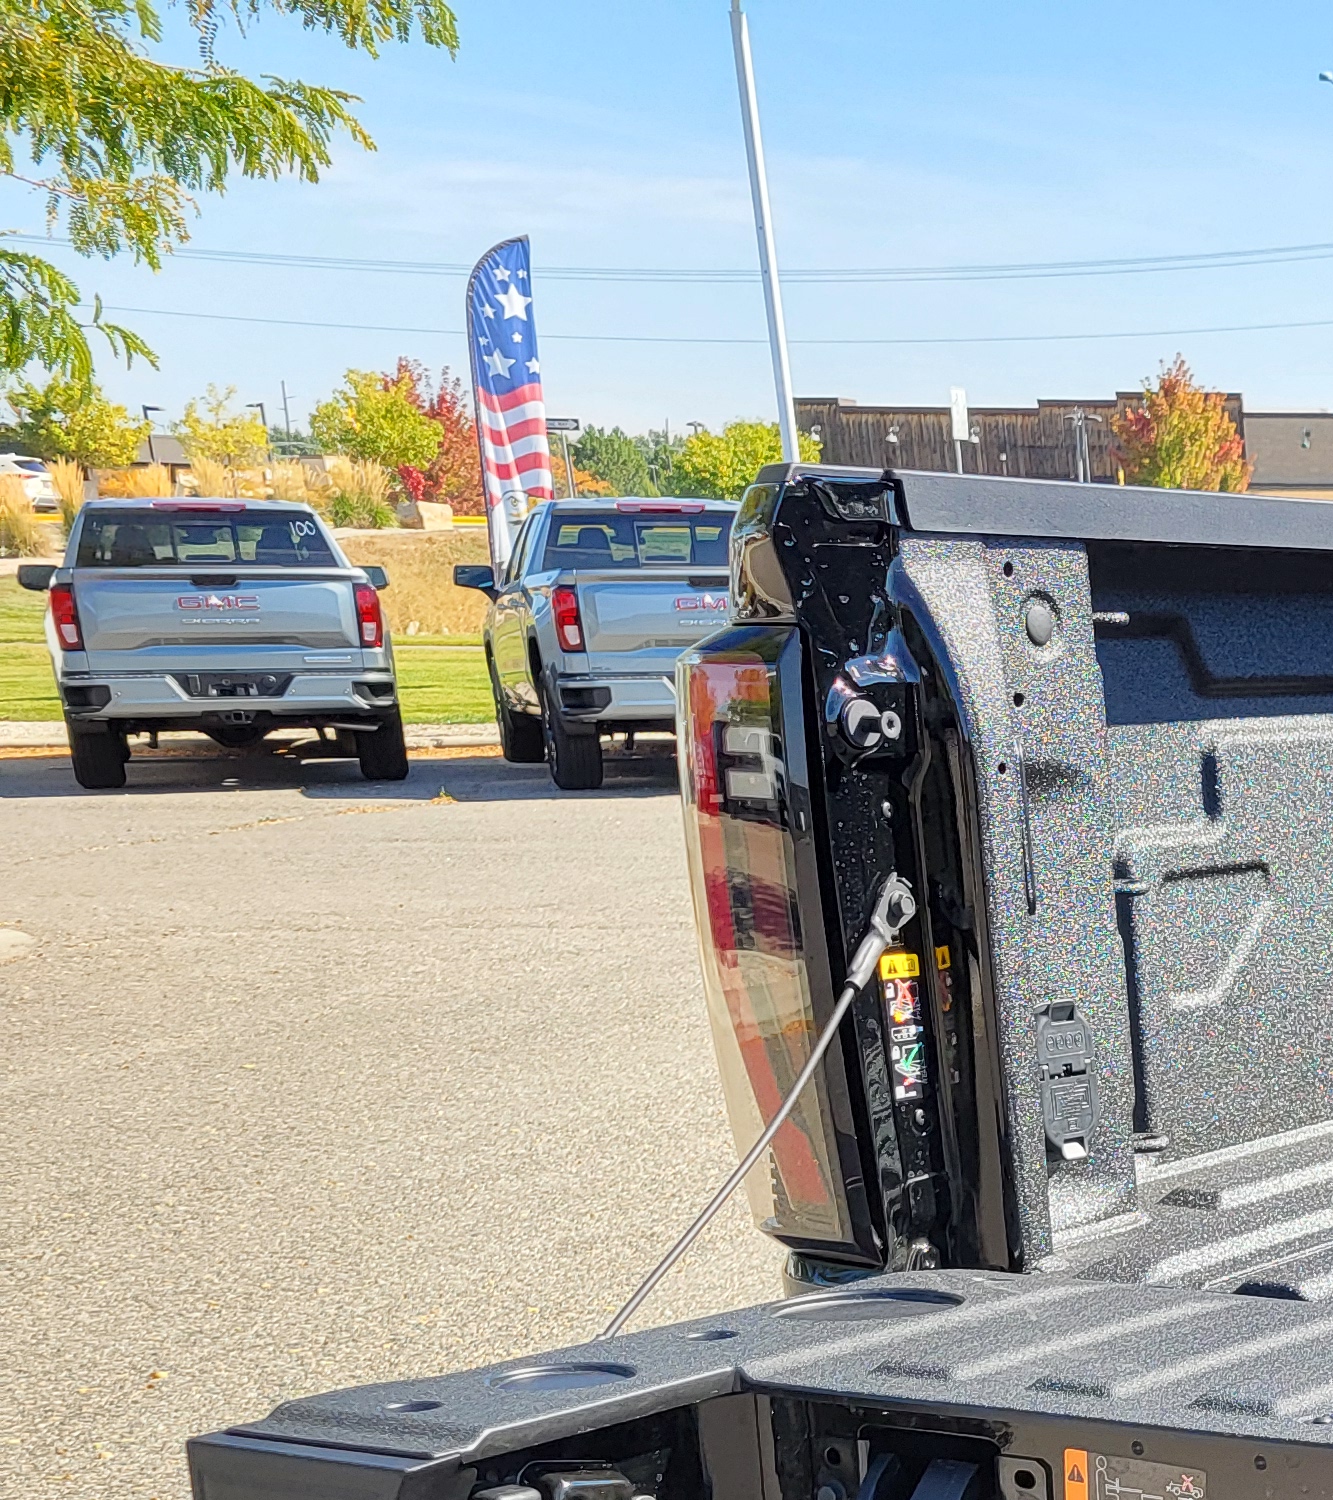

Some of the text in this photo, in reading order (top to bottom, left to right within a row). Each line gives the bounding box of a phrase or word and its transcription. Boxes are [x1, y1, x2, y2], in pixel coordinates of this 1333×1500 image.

[289, 521, 316, 537] 100
[177, 595, 260, 610] GMC
[675, 597, 727, 610] GM
